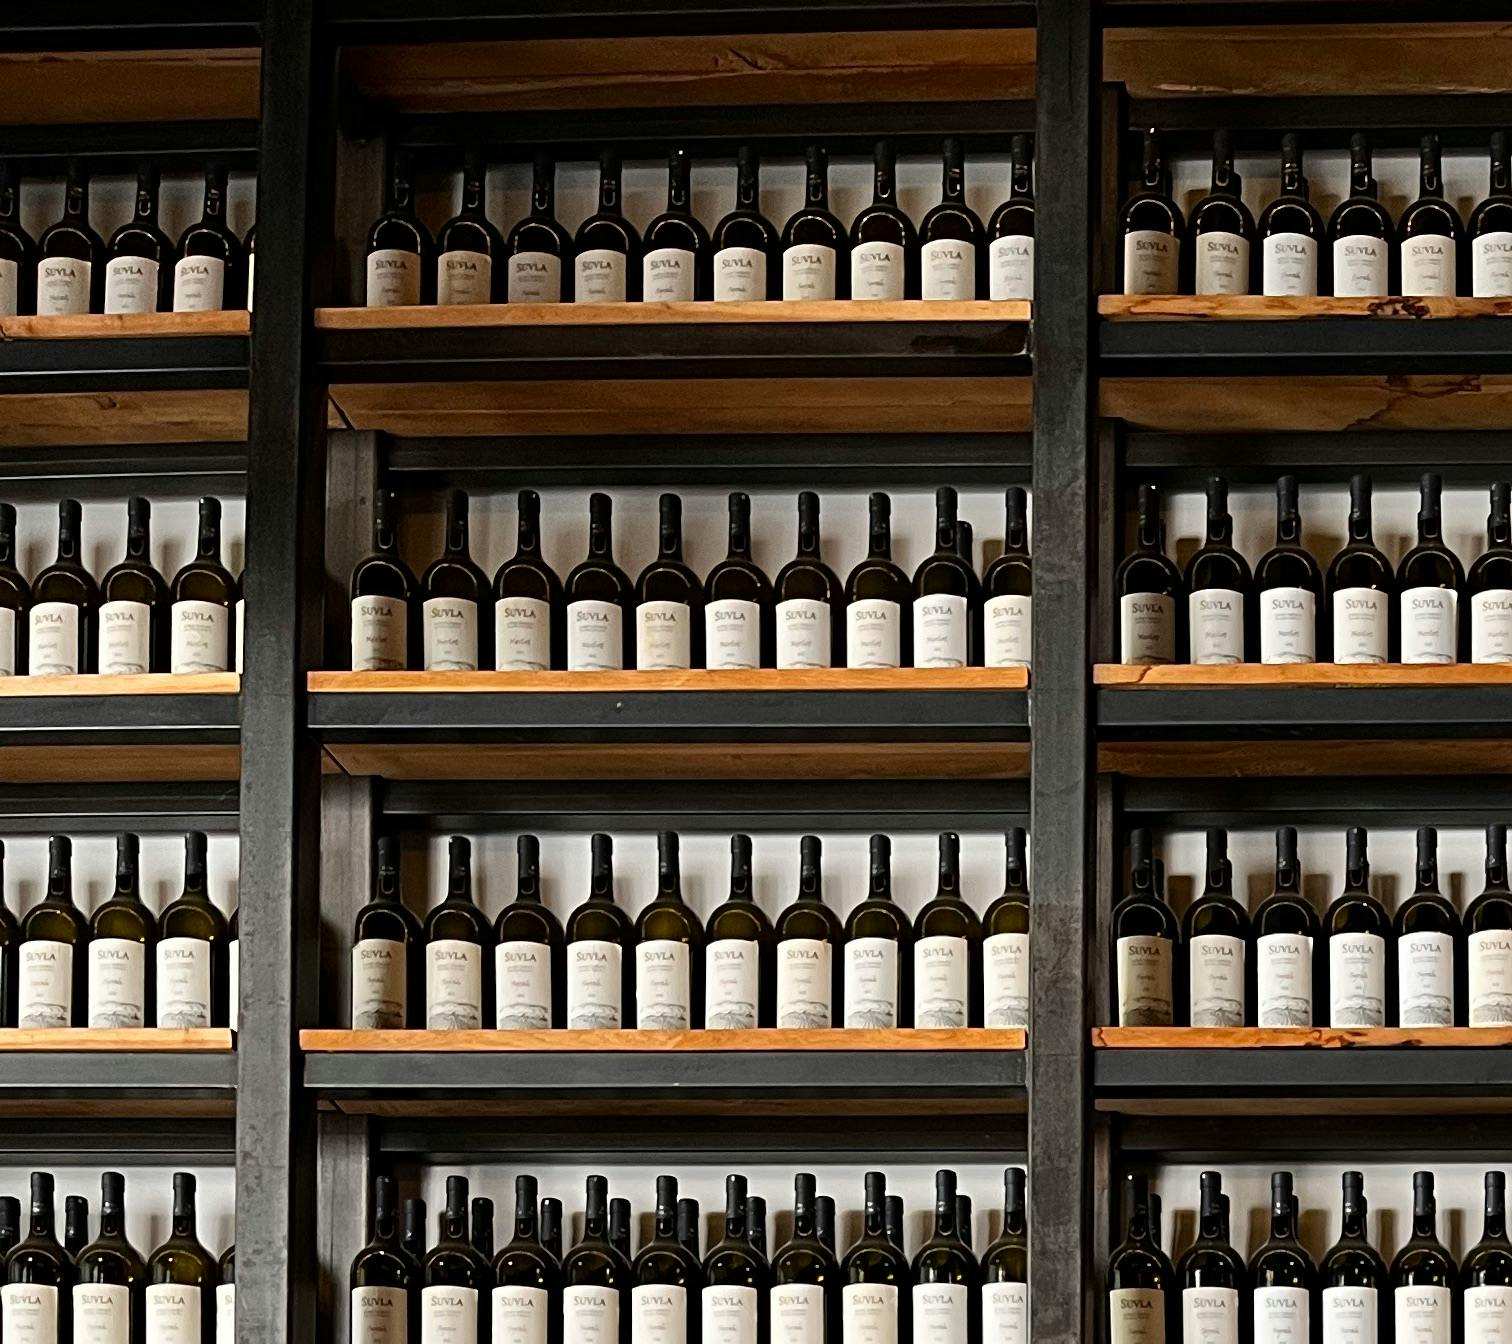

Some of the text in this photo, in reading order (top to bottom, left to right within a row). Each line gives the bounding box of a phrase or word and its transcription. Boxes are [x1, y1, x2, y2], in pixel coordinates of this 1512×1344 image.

[1135, 238, 1169, 254] SUVLA
[1207, 241, 1240, 256] SUVLA
[1274, 243, 1308, 256] SUVLA
[1411, 245, 1445, 257] SUVLA
[931, 250, 964, 262] SUVLA
[375, 259, 409, 271] SUVLA
[445, 259, 478, 273] SUVLA
[581, 260, 613, 273] SUVLA
[721, 258, 753, 270] SUVLA
[44, 266, 77, 279] SUVLA
[1131, 602, 1165, 616] SUVLA
[1199, 599, 1233, 611] SUVLA
[1271, 598, 1305, 611] SUVLA
[1345, 598, 1378, 611] SUVLA
[181, 610, 216, 624] SUVLA
[360, 605, 395, 619] SUVLA
[431, 607, 465, 620] SUVLA
[504, 607, 537, 620] SUVLA
[576, 610, 610, 623] SUVLA
[714, 610, 747, 622] SUVLA
[855, 610, 888, 622] SUVLA
[786, 949, 820, 960] SUVLA
[1128, 945, 1161, 957] SUVLA
[1201, 944, 1234, 957] SUVLA
[1268, 944, 1301, 956] SUVLA
[1341, 943, 1375, 955] SUVLA
[1410, 943, 1443, 954] SUVLA
[97, 949, 130, 961] SUVLA
[360, 949, 393, 961] SUVLA
[434, 949, 469, 962] SUVLA
[504, 951, 538, 963] SUVLA
[576, 951, 609, 963] SUVLA
[81, 1294, 114, 1305] SUVLA
[361, 1296, 394, 1308] SUVLA
[431, 1295, 464, 1308] SUVLA
[573, 1295, 607, 1308] SUVLA
[640, 1295, 674, 1307] SUVLA
[1120, 1298, 1154, 1310] SUVLA
[1193, 1297, 1227, 1309] SUVLA
[1265, 1297, 1299, 1309] SUVLA
[1406, 1296, 1439, 1308] SUVLA
